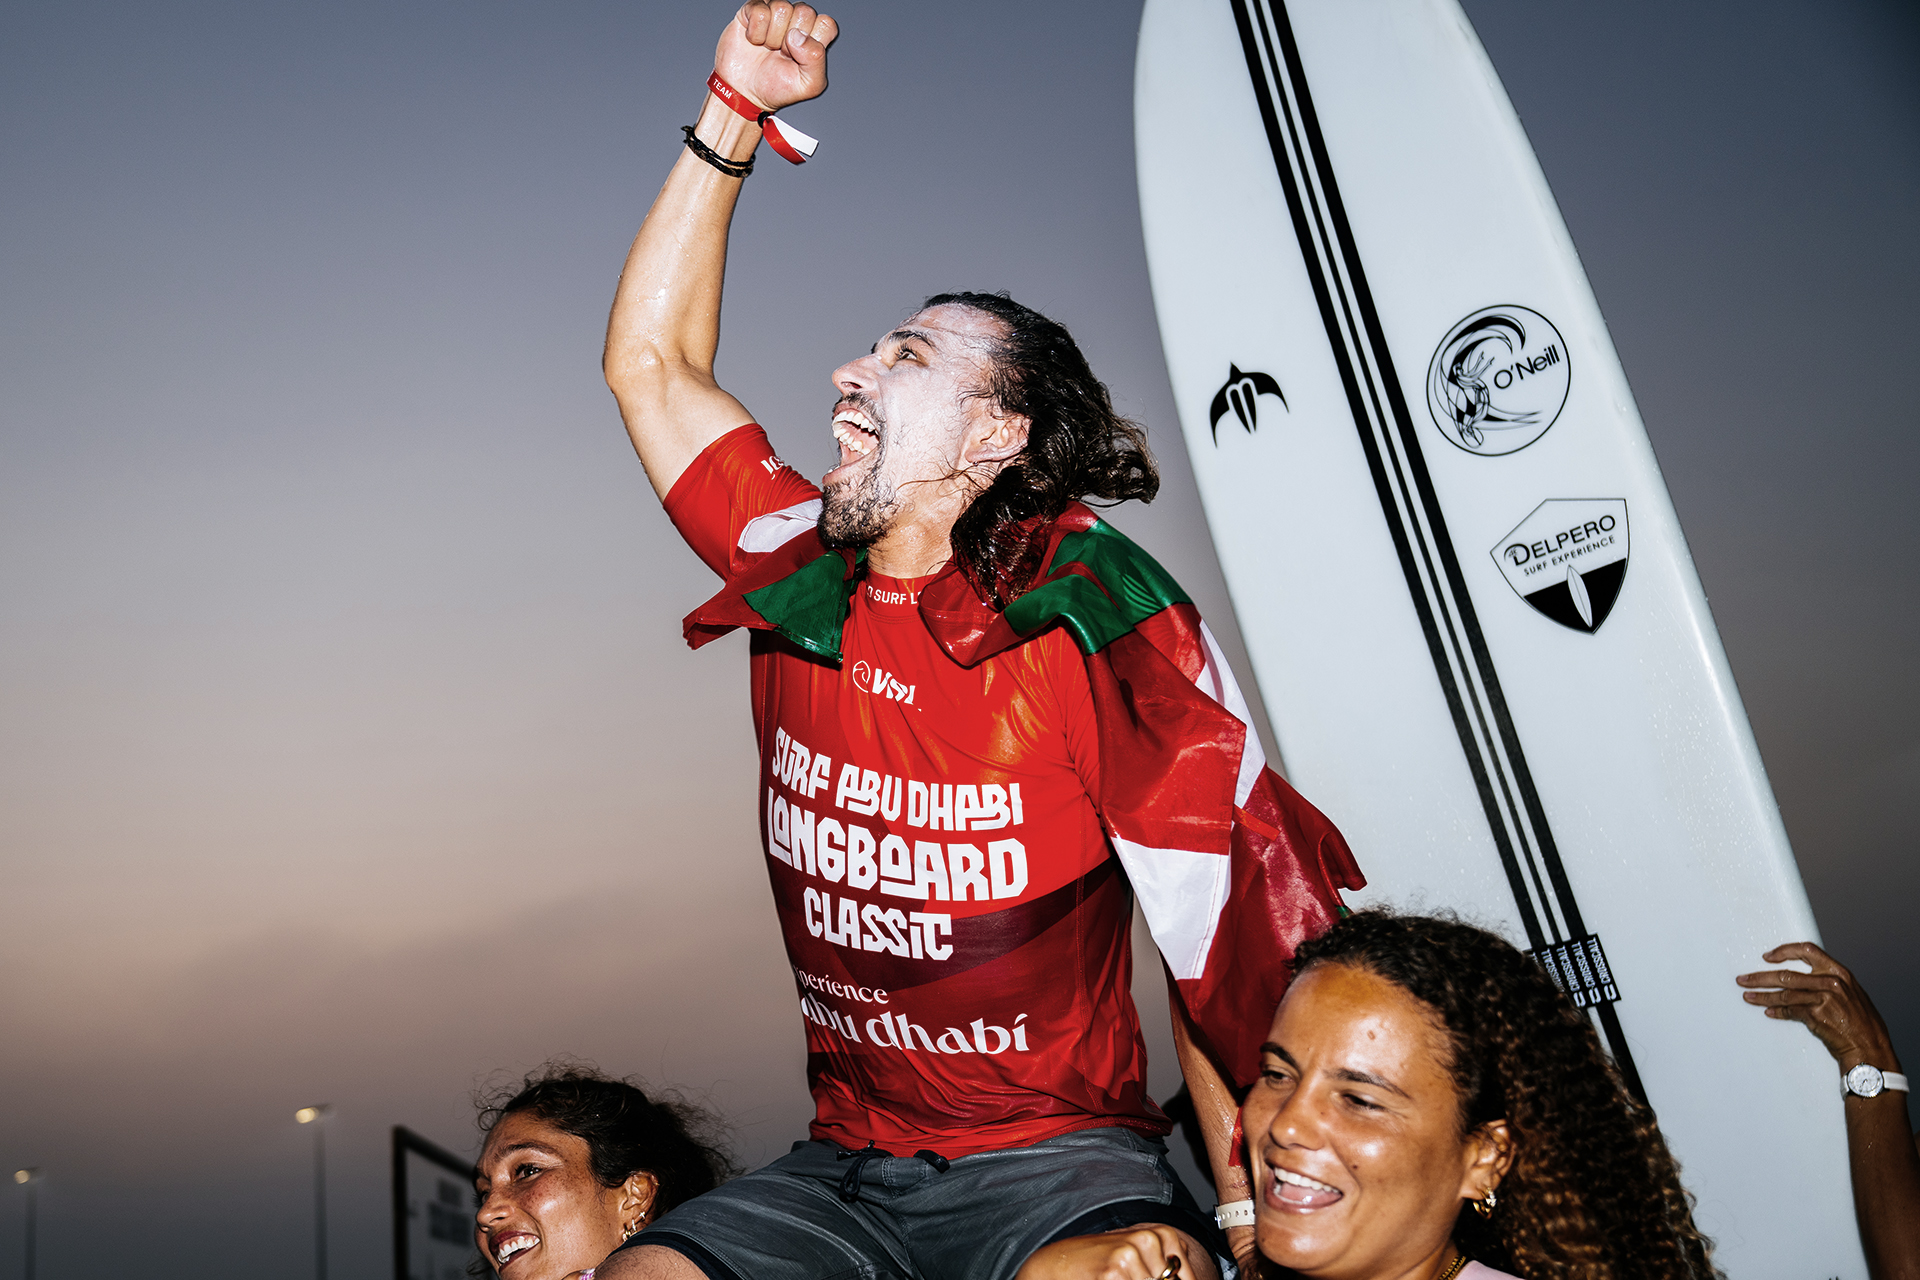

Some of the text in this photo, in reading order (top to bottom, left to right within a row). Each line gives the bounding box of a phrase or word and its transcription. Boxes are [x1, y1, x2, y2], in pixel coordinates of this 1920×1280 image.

[712, 78, 733, 100] TEAM
[1494, 344, 1560, 390] O'Neill
[1503, 514, 1617, 567] DELPERO
[1523, 535, 1616, 578] SURF EXPERIENCE
[873, 588, 907, 605] SURF
[772, 726, 1024, 831] SURF ABU DHABI
[767, 786, 1029, 902] LONGBOARD
[803, 886, 954, 961] CLASSIC
